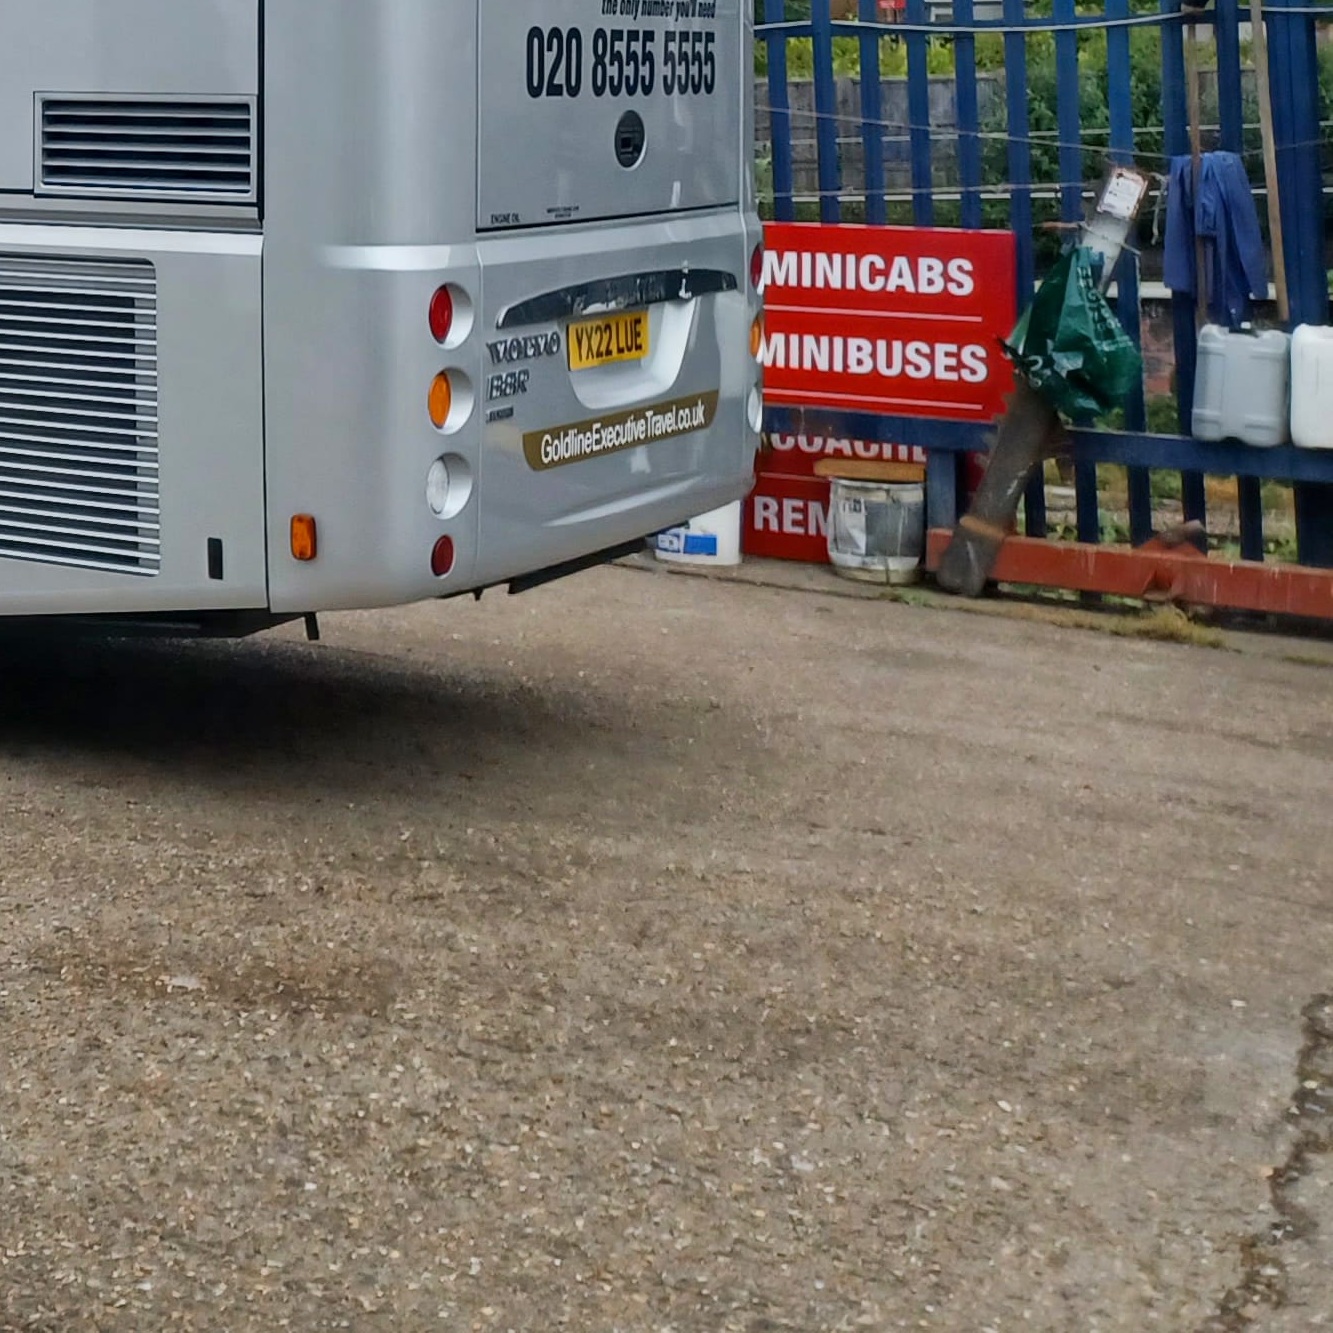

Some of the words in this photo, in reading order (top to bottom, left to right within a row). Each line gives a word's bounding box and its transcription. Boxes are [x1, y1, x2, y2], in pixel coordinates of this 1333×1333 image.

[526, 26, 582, 98] 020
[592, 28, 655, 97] 8555
[663, 30, 715, 96] 5555
[763, 249, 974, 296] MINICABS
[486, 331, 561, 363] VOLVO
[575, 325, 612, 362] YX22
[616, 318, 642, 355] LUE
[762, 332, 988, 383] MINIBUSES
[487, 369, 529, 401] B8R
[541, 399, 705, 463] GoldlineExecutiveTravel.co.uk
